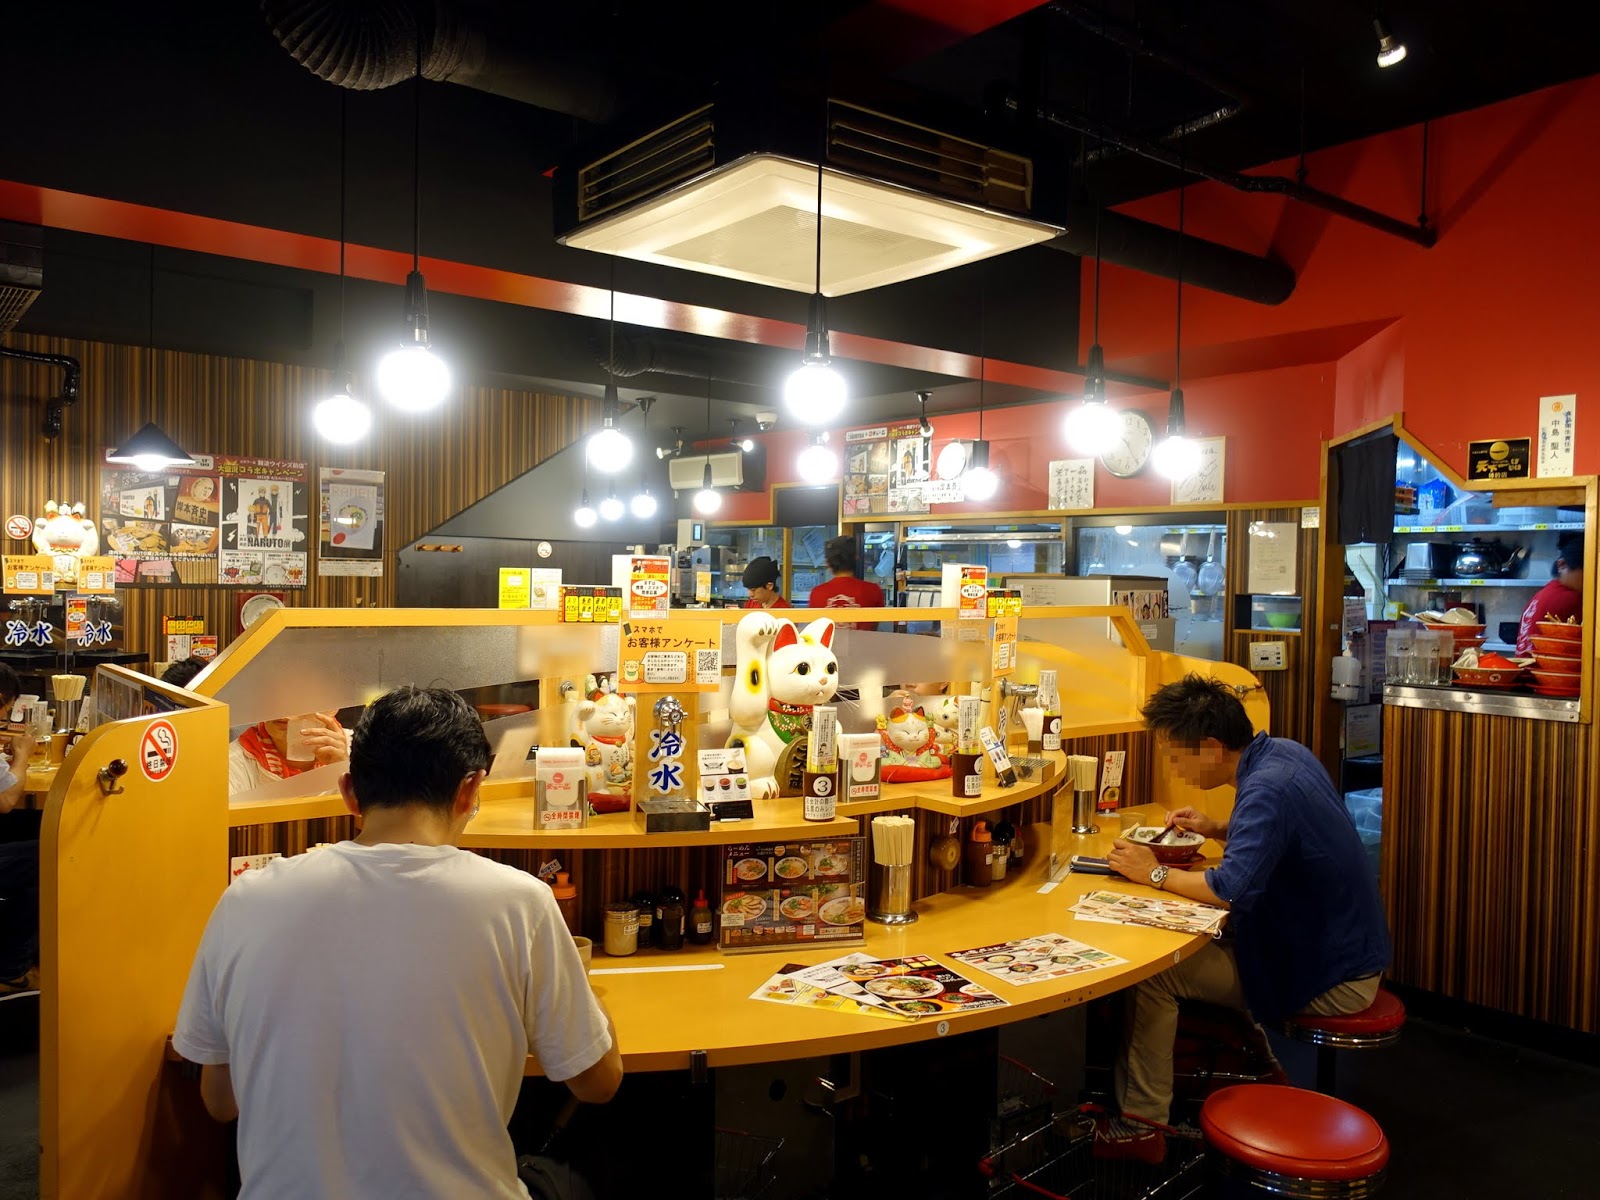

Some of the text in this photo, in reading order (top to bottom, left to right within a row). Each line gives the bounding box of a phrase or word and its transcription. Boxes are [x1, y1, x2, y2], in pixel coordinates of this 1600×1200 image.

[1475, 458, 1522, 474] 天下一品
[176, 501, 208, 519] 岸本斉史
[247, 537, 291, 548] NARUTO展
[7, 620, 52, 644] 冷水
[79, 622, 112, 644] 冷水
[633, 625, 663, 634] スマホで
[627, 637, 716, 648] お客様アンケート
[1054, 722, 1060, 730] 1
[651, 730, 683, 791] 冷水
[817, 780, 828, 793] 3
[551, 811, 580, 820] 全時間禁煙
[940, 1023, 946, 1033] 3
